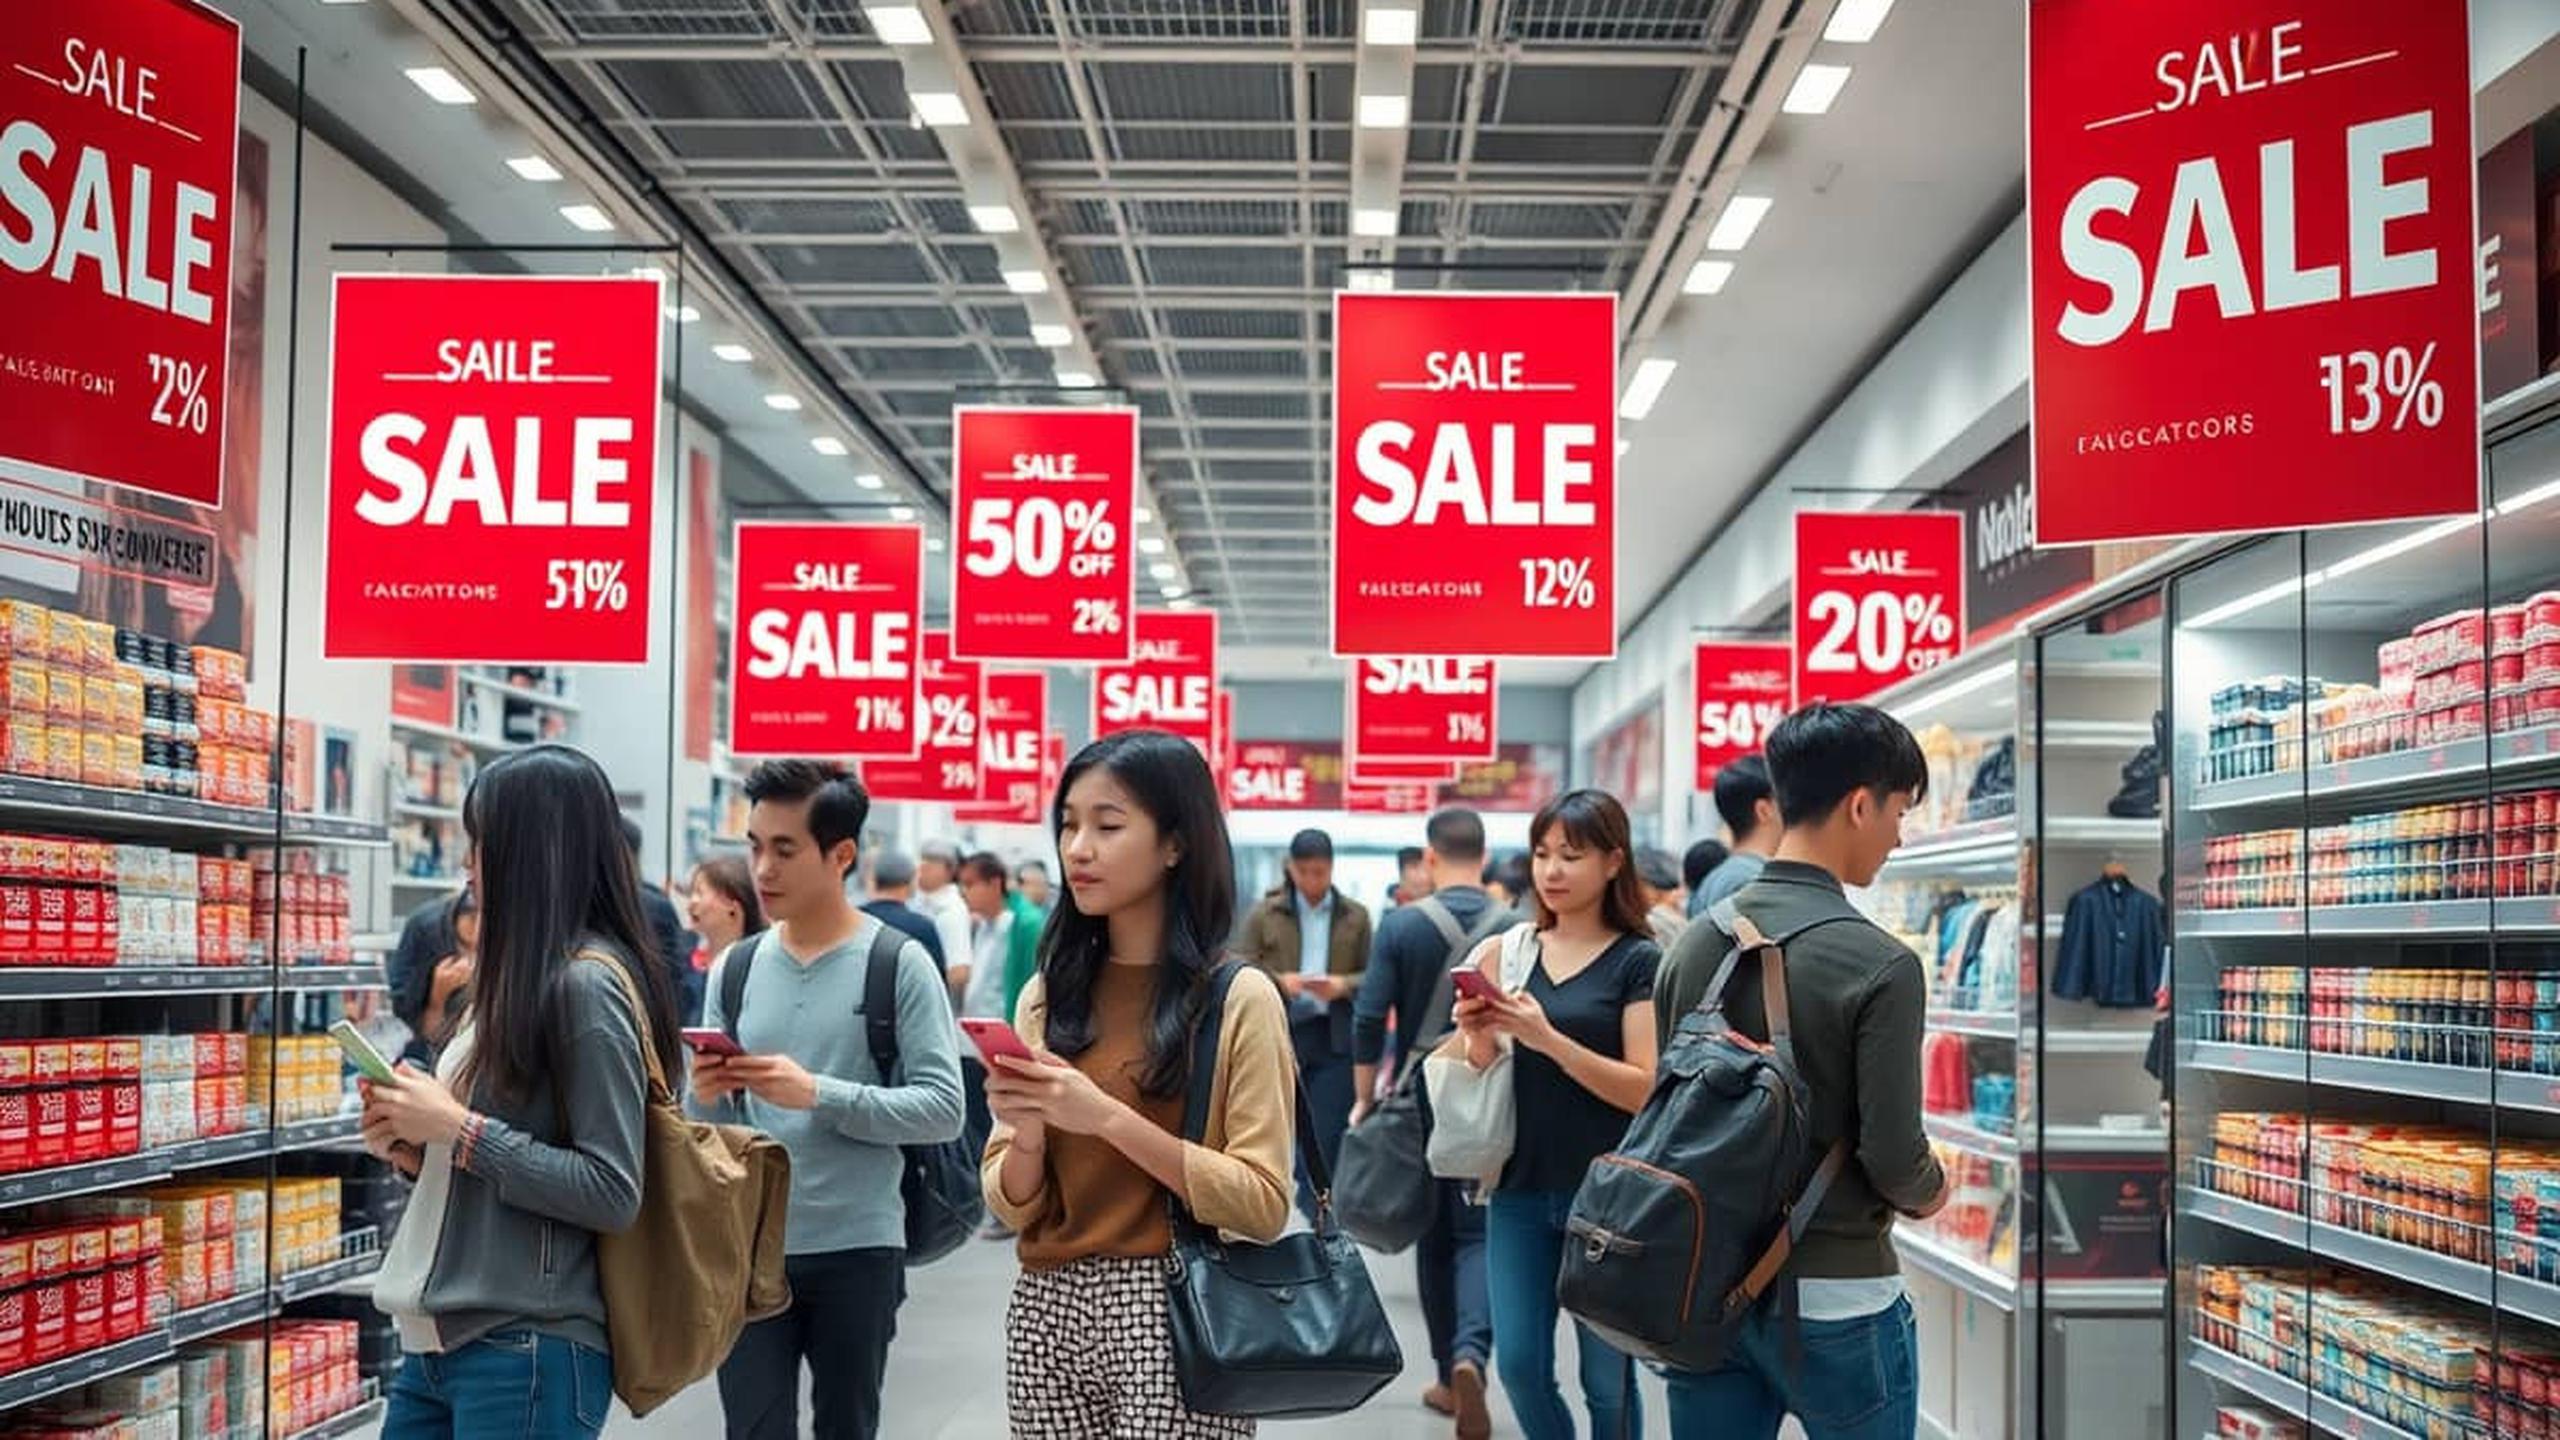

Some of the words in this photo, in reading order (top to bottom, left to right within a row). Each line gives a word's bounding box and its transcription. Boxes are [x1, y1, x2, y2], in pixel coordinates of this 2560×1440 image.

[62, 38, 157, 123] SALE
[2155, 21, 2305, 113] SALE
[0, 118, 216, 324] SALE
[2057, 109, 2438, 348] SALE
[1426, 351, 1526, 391] SALE
[355, 412, 633, 527] SALE
[1012, 454, 1077, 481] SALE
[1352, 420, 1596, 526] SALE
[965, 498, 1116, 577] 50%
[1069, 553, 1114, 577] OFF
[1848, 550, 1910, 574] SALE
[794, 563, 861, 591] SALE
[1520, 557, 1595, 608] 12%
[748, 609, 909, 679] SALE
[1806, 590, 1954, 673] 20%
[1103, 673, 1209, 722] SALE
[1364, 658, 1487, 694] SALE
[1231, 767, 1305, 802] SALE
